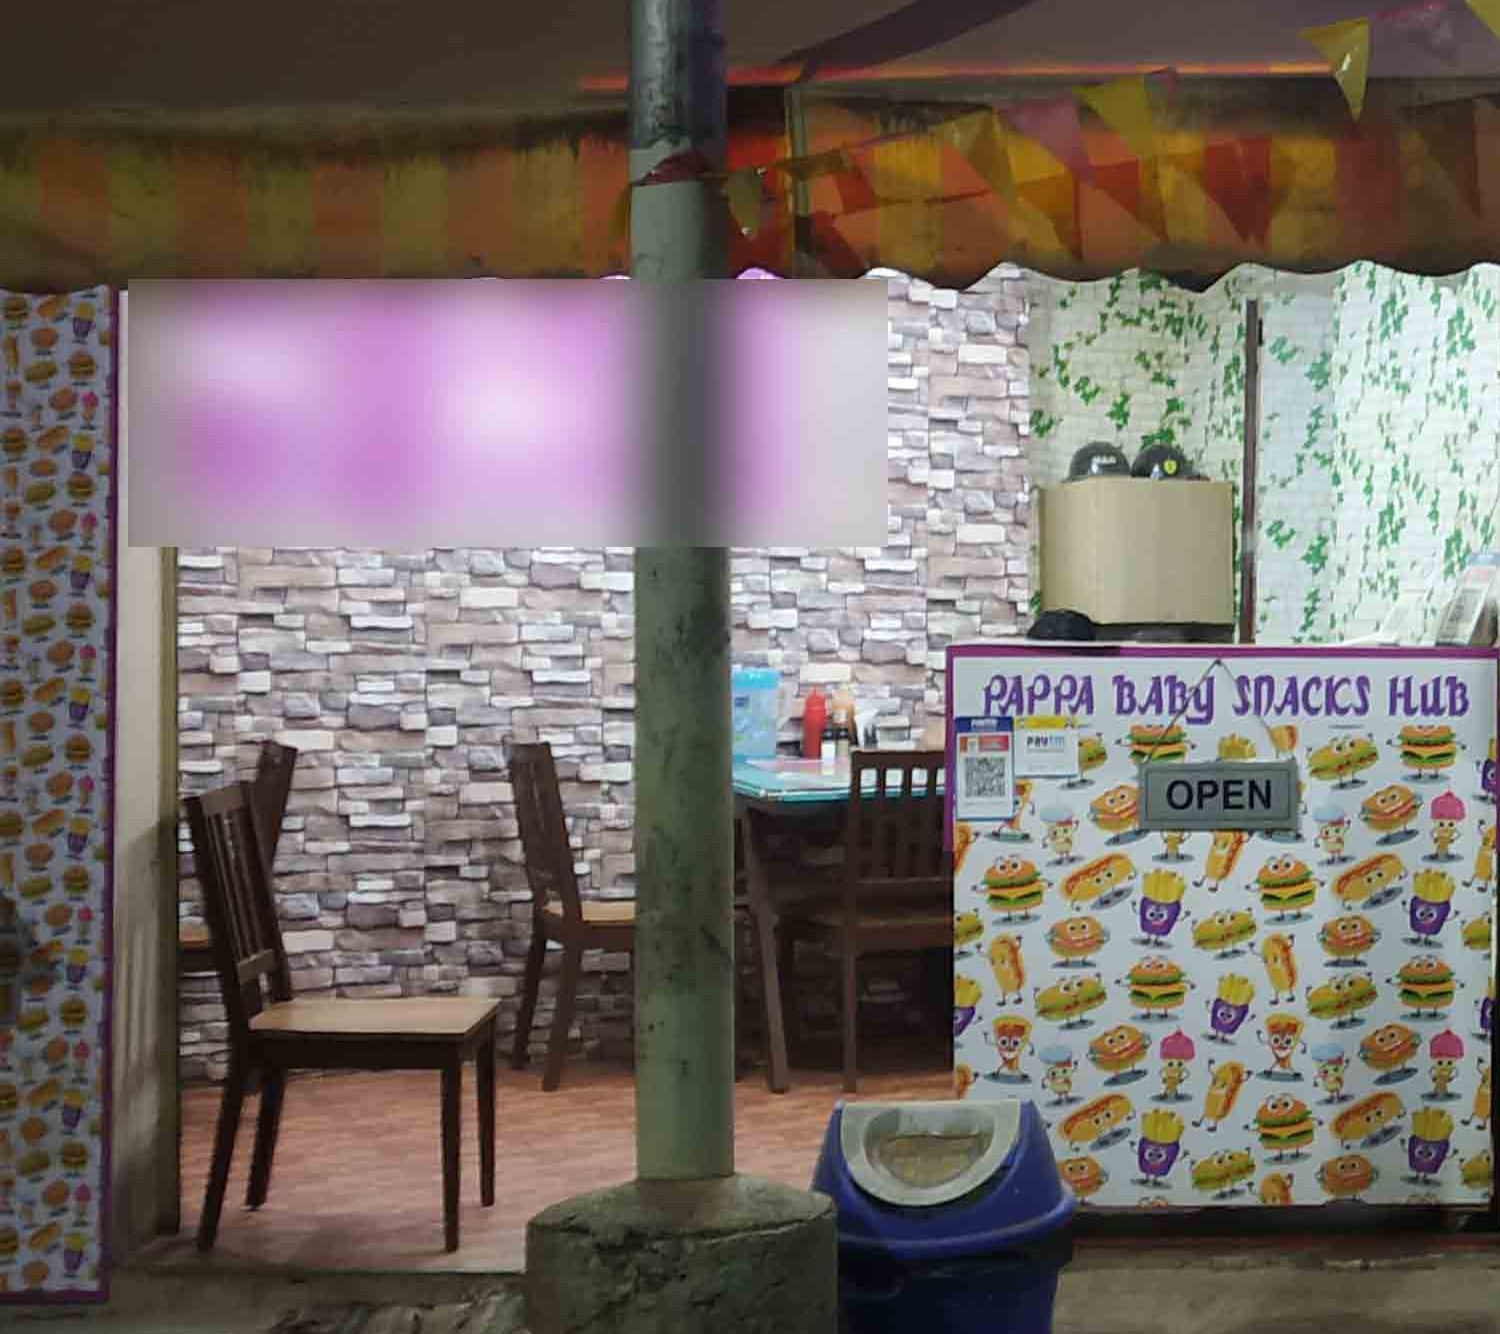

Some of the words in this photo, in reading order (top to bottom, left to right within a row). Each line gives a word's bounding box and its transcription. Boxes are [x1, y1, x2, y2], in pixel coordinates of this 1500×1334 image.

[983, 673, 1095, 717] PAPPA
[1231, 673, 1372, 717] SNACKS
[1387, 674, 1470, 717] HUB
[1165, 779, 1273, 812] OPEN
